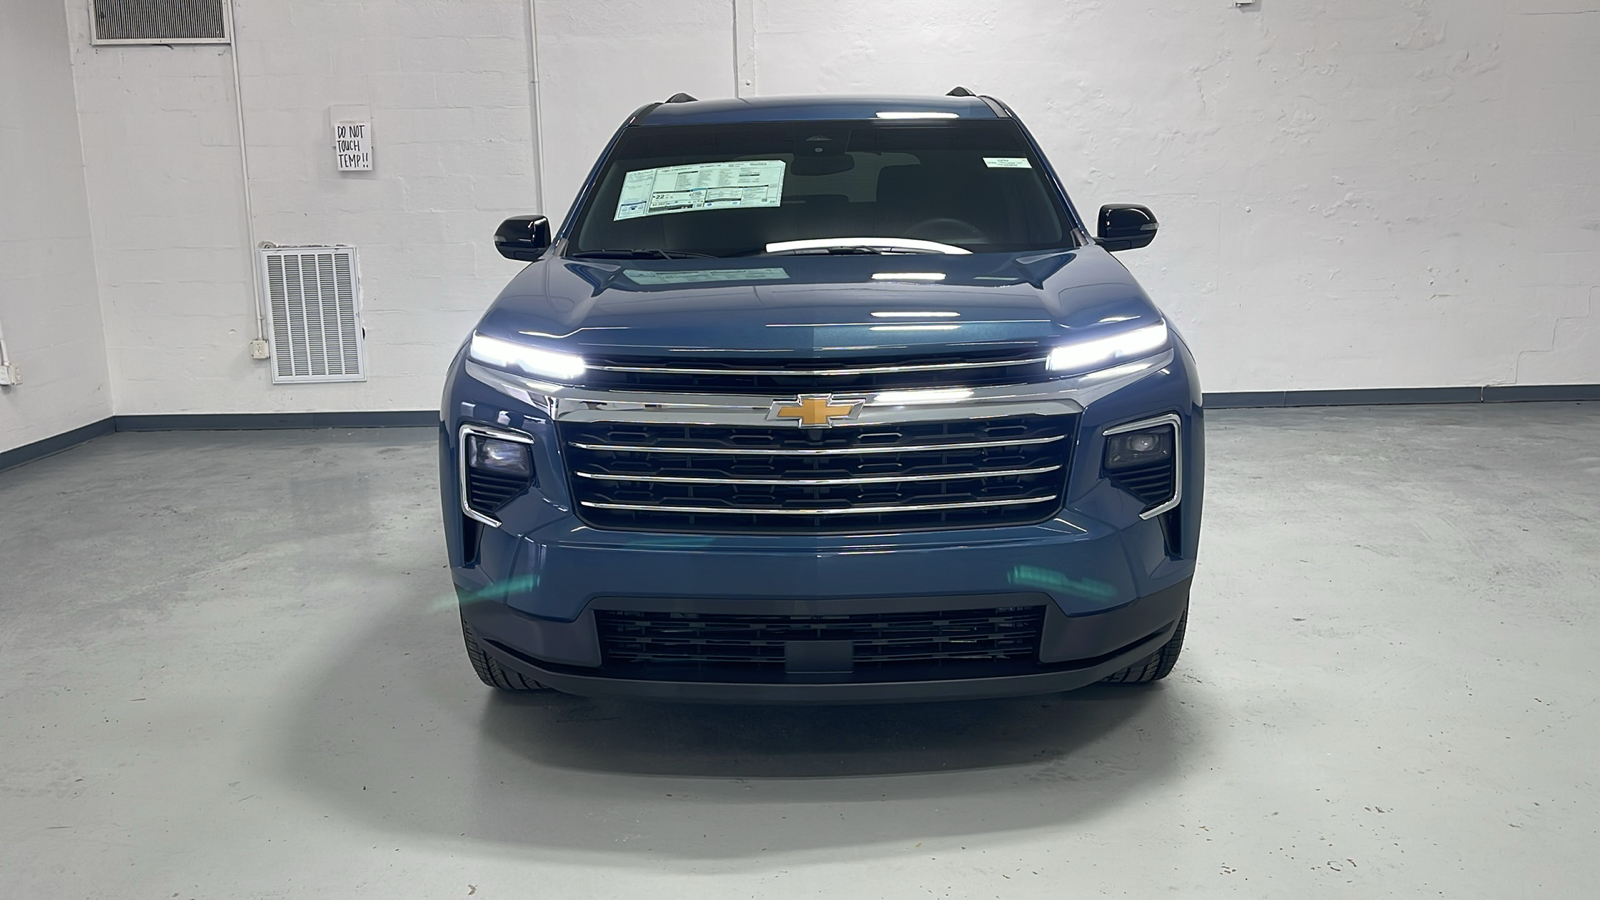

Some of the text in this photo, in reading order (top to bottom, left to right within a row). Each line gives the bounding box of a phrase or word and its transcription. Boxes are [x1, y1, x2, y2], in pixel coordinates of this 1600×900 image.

[337, 125, 365, 139] DO NOT
[337, 140, 360, 153] TOUCH
[338, 152, 368, 168] TEMP!!
